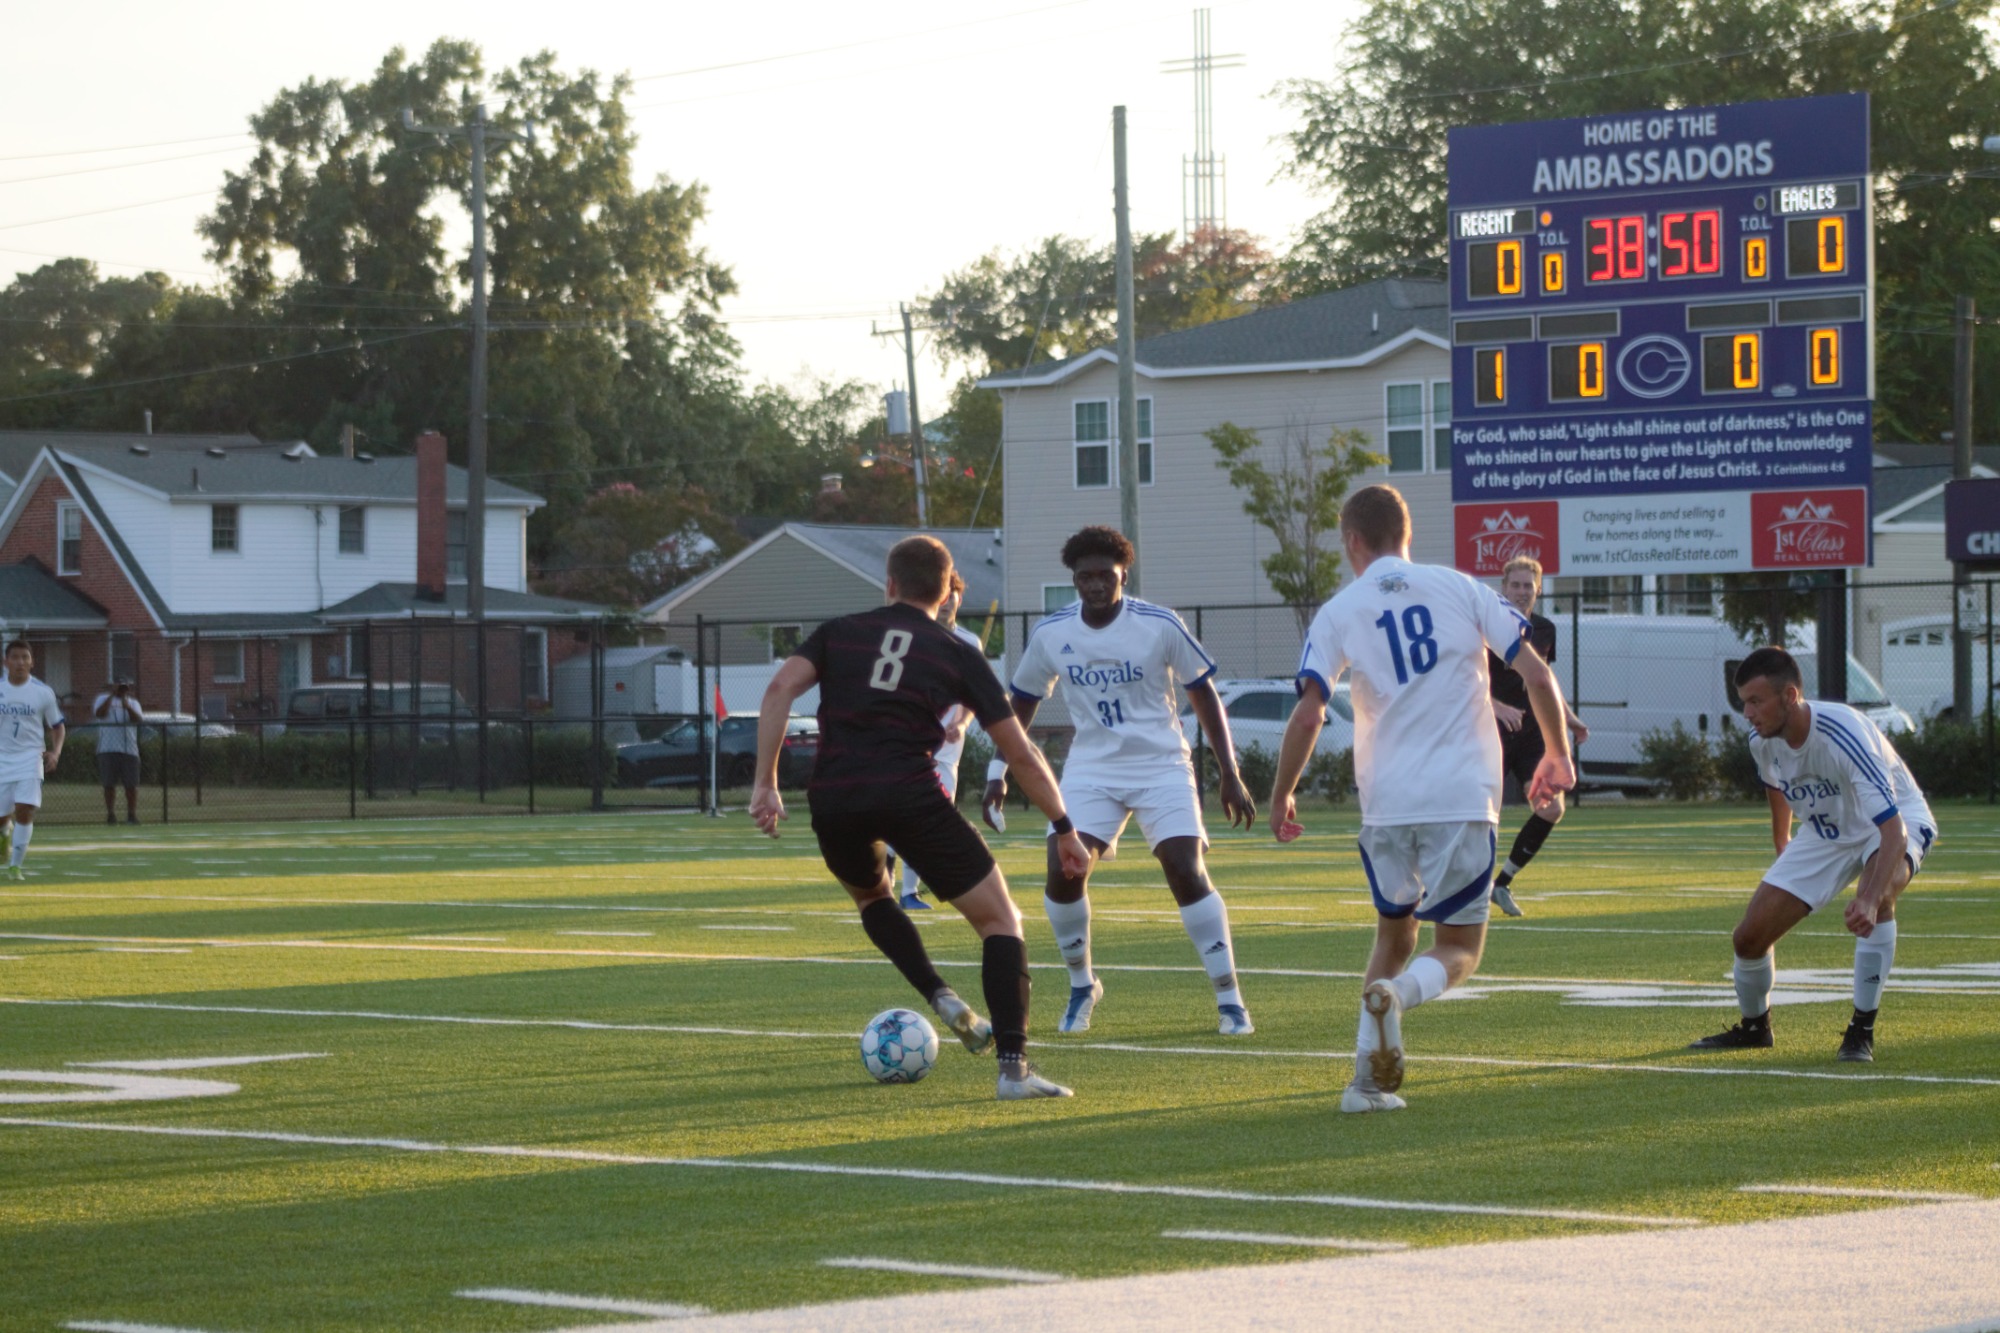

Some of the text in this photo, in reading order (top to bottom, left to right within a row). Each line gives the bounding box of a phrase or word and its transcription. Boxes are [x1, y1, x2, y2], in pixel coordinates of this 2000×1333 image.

[1583, 113, 1717, 146] HOME OF THE
[1532, 140, 1774, 193] AMBASSADORS
[1780, 184, 1837, 213] EAGLES
[1461, 209, 1516, 237] REGENT
[1538, 230, 1569, 246] T.O.L.
[1740, 216, 1772, 231] T.O.L.
[1591, 210, 1719, 281] 38:50
[1747, 238, 1766, 277] 0
[1818, 216, 1844, 272] 0
[1497, 240, 1521, 294] 0
[1545, 252, 1563, 291] 0
[1579, 342, 1603, 397] 0
[1733, 333, 1759, 389] 0
[1812, 328, 1838, 384] 0
[1494, 350, 1503, 400] 1
[1453, 429, 1474, 444] For
[1476, 427, 1507, 444] God,
[1509, 426, 1536, 442] who
[1539, 425, 1569, 441] said,
[1570, 422, 1609, 442] "Light
[1612, 420, 1642, 438] shall
[1645, 418, 1681, 436] shine
[1683, 418, 1706, 433] out
[1709, 416, 1725, 433] of
[1797, 413, 1808, 428] is
[1810, 412, 1834, 427] the
[1836, 410, 1865, 425] One
[1465, 435, 1852, 466] who shined in our hearts to give the Light of the knowledge
[1473, 461, 1846, 490] of the glory of God in the face of Jesus Christ. 2 Corinthians 4:6
[1583, 506, 1725, 524] Changing lives and selling a
[1585, 530, 1603, 542] few
[1605, 528, 1639, 542] homes
[1641, 527, 1671, 543] along
[1673, 527, 1691, 539] the
[1775, 522, 1845, 553] 1st Class
[1475, 539, 1494, 563] 1st
[1571, 548, 1738, 564] www.1stClassRealEstate.com
[1774, 551, 1845, 562] REAL ESTATE
[1475, 563, 1499, 571] REAL
[1375, 604, 1438, 685] 18
[870, 629, 913, 692] 8
[1066, 660, 1144, 693] Royals
[1097, 698, 1124, 728] 31
[12, 721, 19, 738] 7
[1808, 813, 1840, 840] 15
